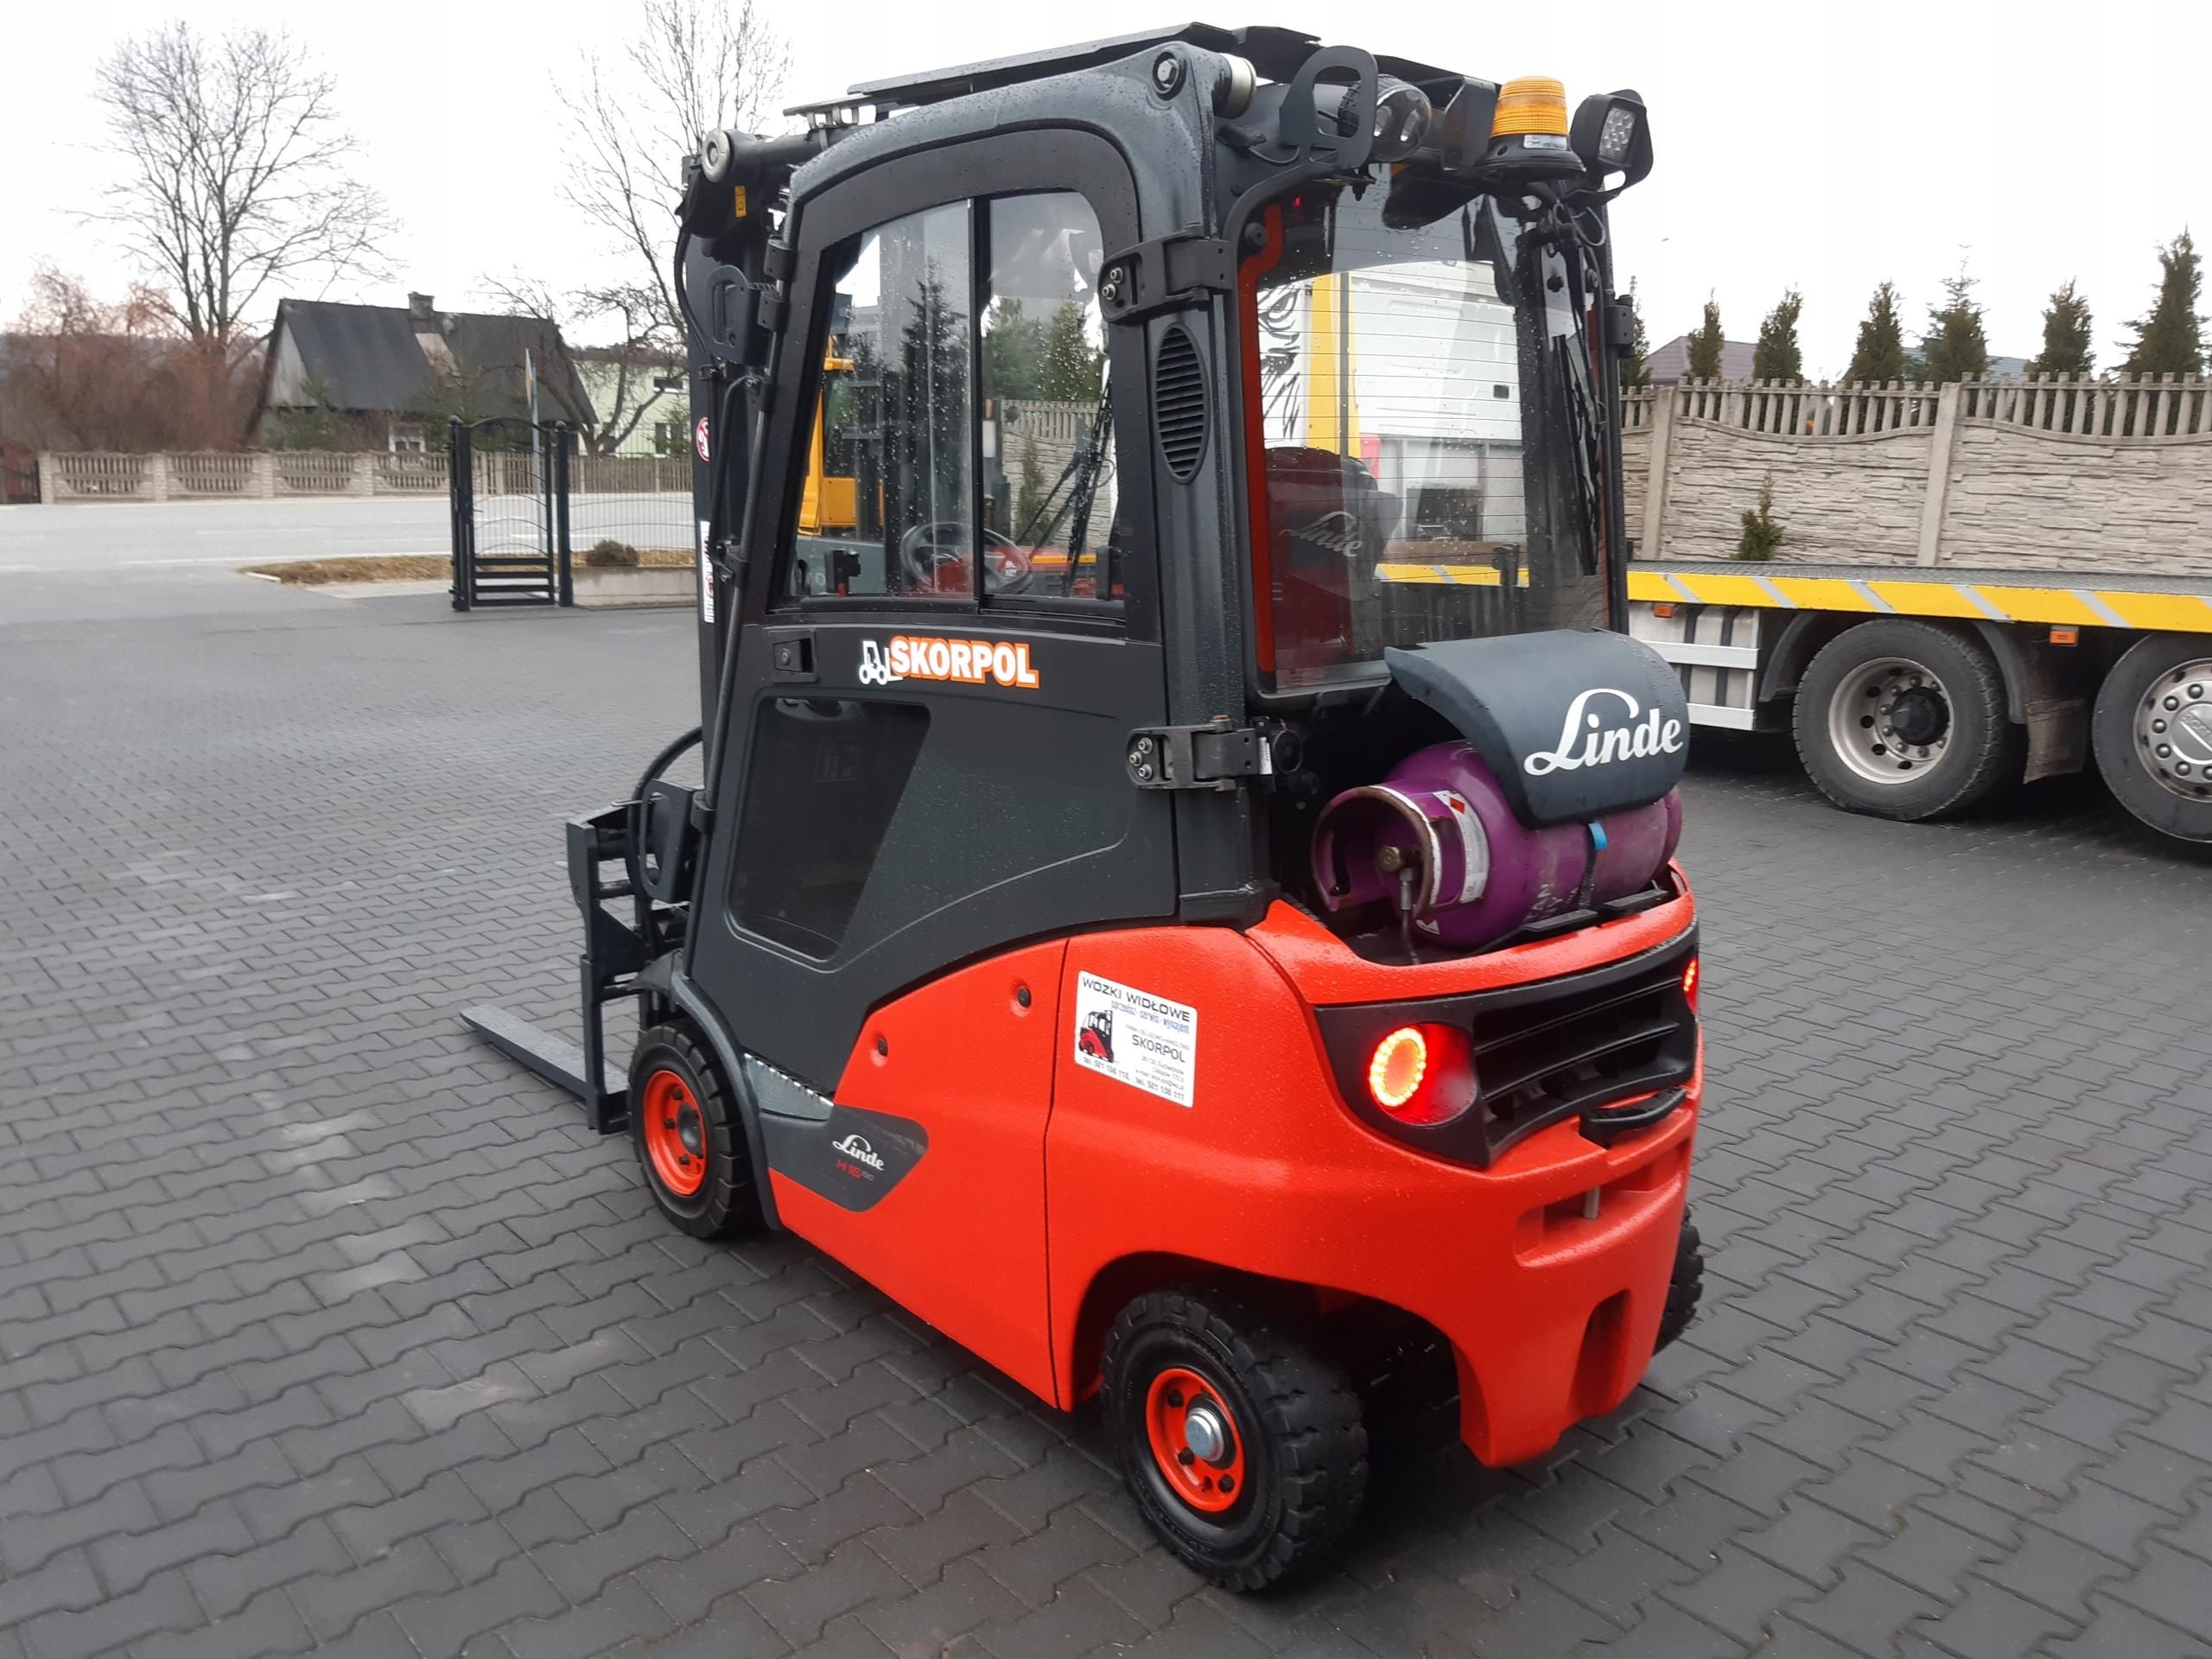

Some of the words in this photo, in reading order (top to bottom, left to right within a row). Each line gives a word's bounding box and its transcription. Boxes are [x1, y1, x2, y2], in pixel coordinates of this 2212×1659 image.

[890, 635, 1039, 689] SKORPOL
[1524, 689, 1683, 776] Linde
[1127, 992, 1190, 1022] WIDŁOWE
[1132, 1034, 1185, 1063] SKORPOL
[832, 1134, 885, 1171] Linde
